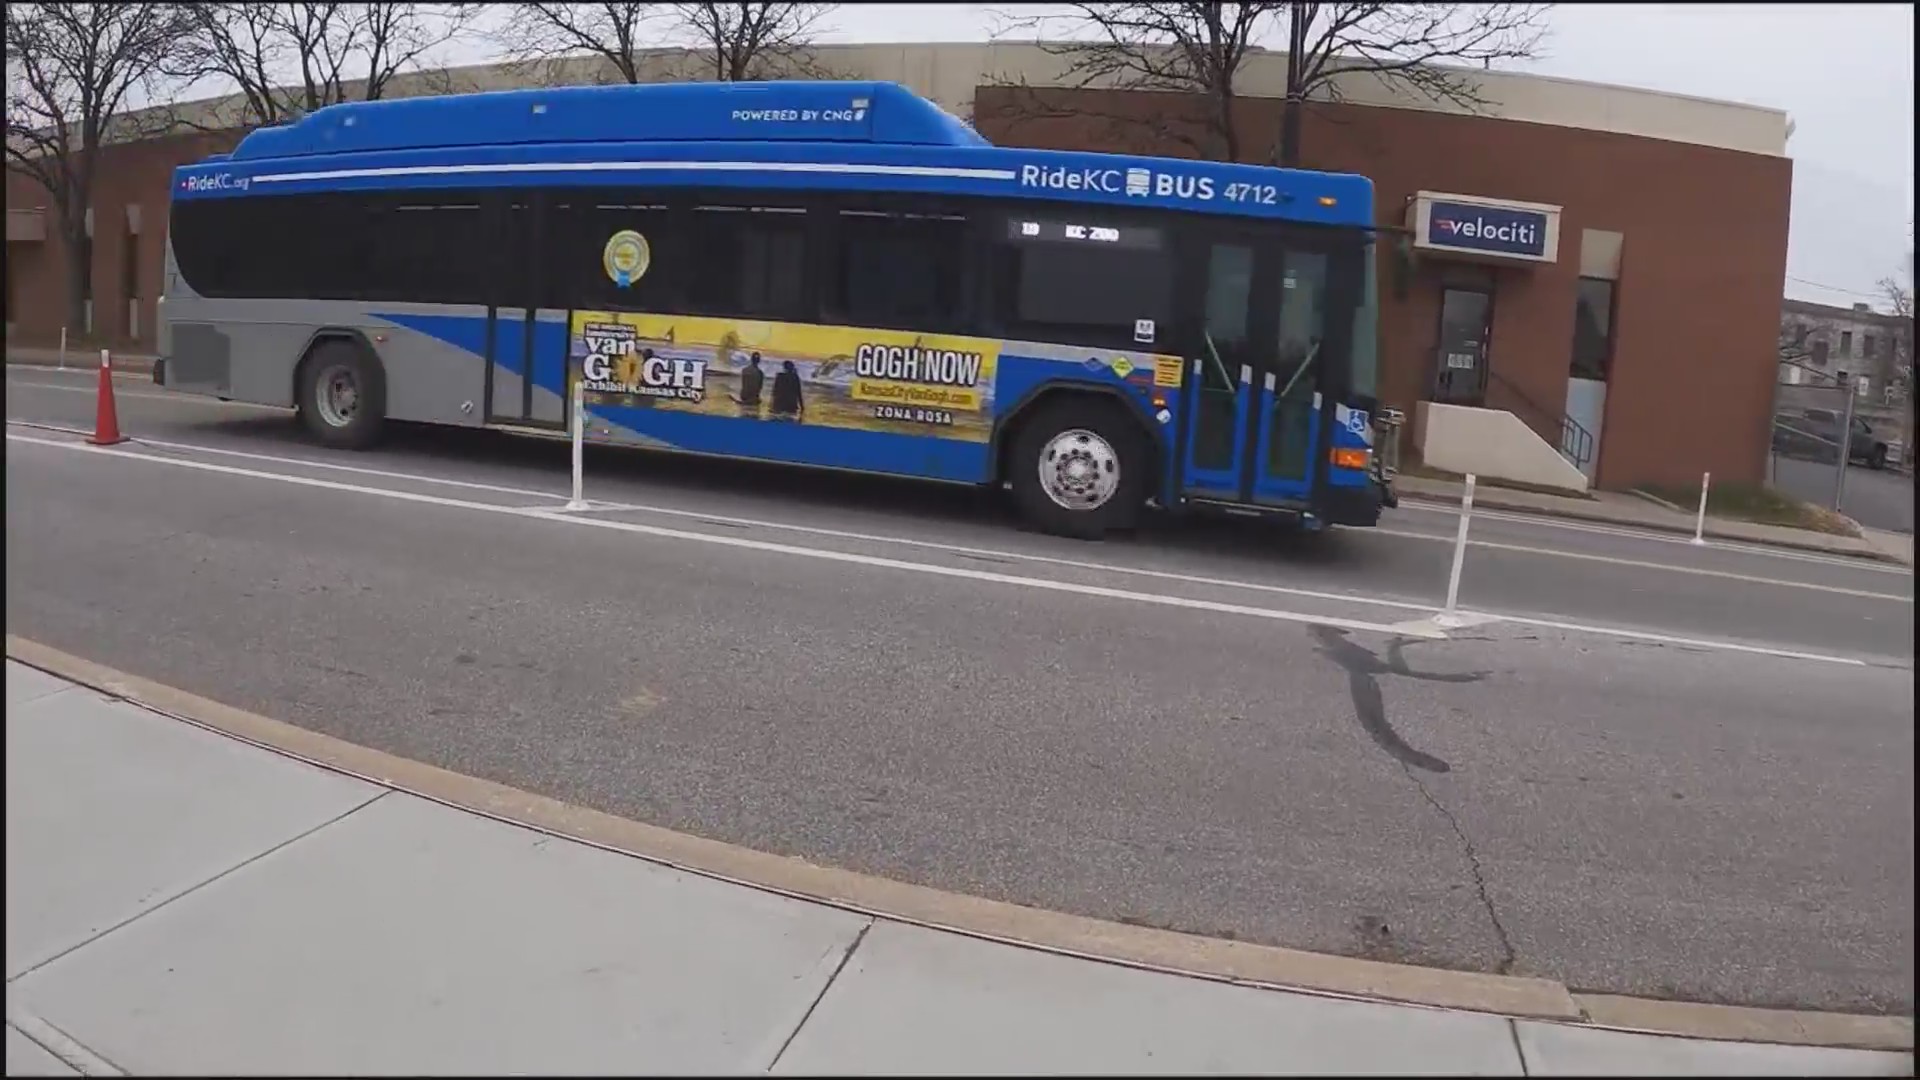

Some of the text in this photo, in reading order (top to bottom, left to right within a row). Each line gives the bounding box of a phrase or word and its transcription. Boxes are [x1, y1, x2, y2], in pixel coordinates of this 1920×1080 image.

[731, 109, 853, 121] POWERED BY CNG
[1021, 164, 1278, 205] RideKC BUS 4712
[1449, 216, 1536, 244] velociti
[584, 336, 635, 355] van
[857, 345, 980, 385] GOGH NOW
[876, 406, 952, 424] ZONA ROSA
